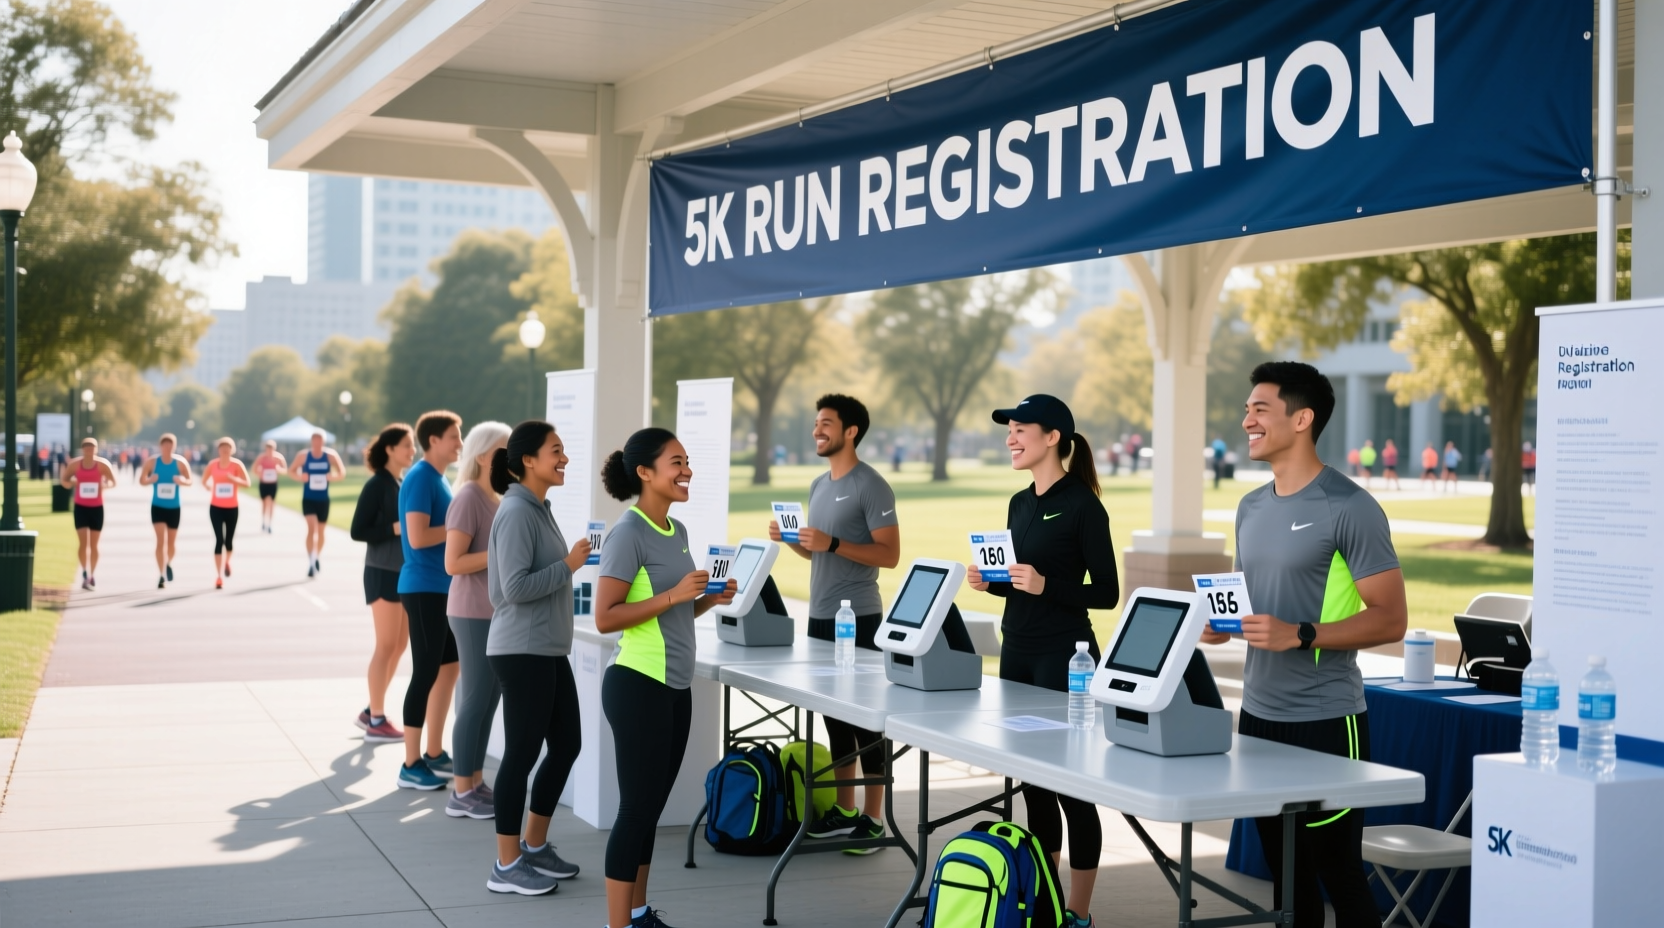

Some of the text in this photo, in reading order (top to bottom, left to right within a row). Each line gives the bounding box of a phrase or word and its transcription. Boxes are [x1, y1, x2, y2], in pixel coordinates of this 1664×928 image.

[684, 12, 1436, 266] 5K RUN REGISTRATION
[1488, 825, 1513, 858] 5K
